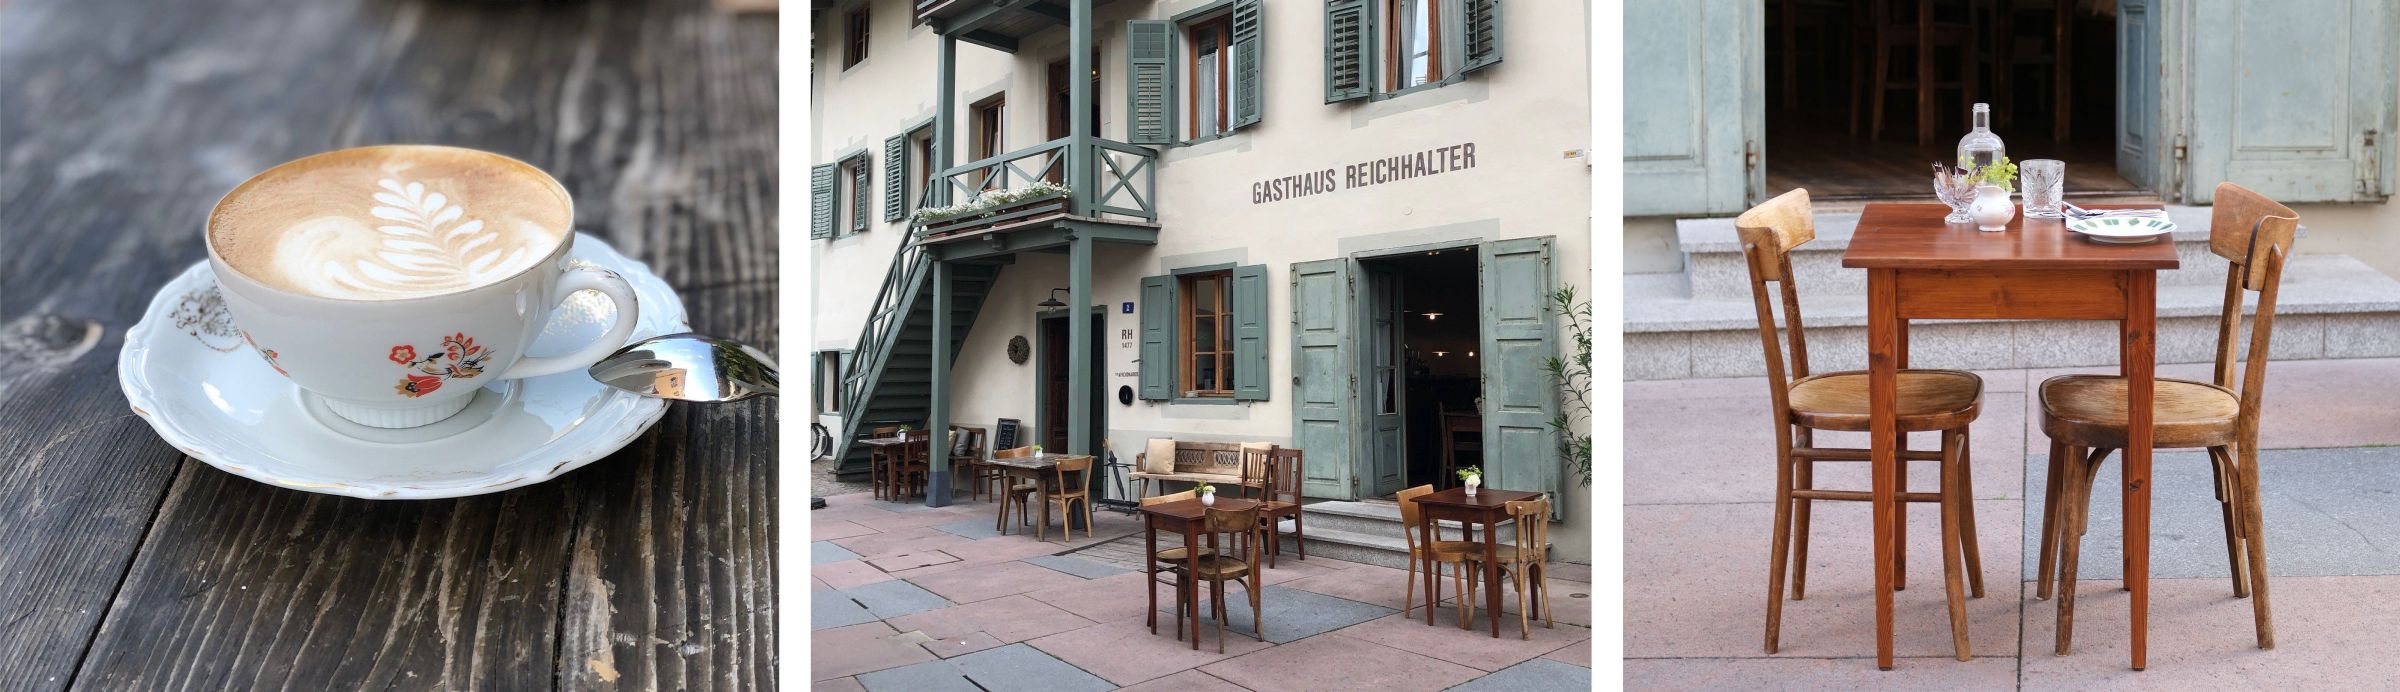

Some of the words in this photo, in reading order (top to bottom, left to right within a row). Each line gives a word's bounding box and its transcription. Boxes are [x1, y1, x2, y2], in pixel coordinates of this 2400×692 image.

[1252, 168, 1336, 205] GASTHAUS
[1346, 142, 1476, 190] REICHHALTER
[1121, 329, 1133, 340] RH
